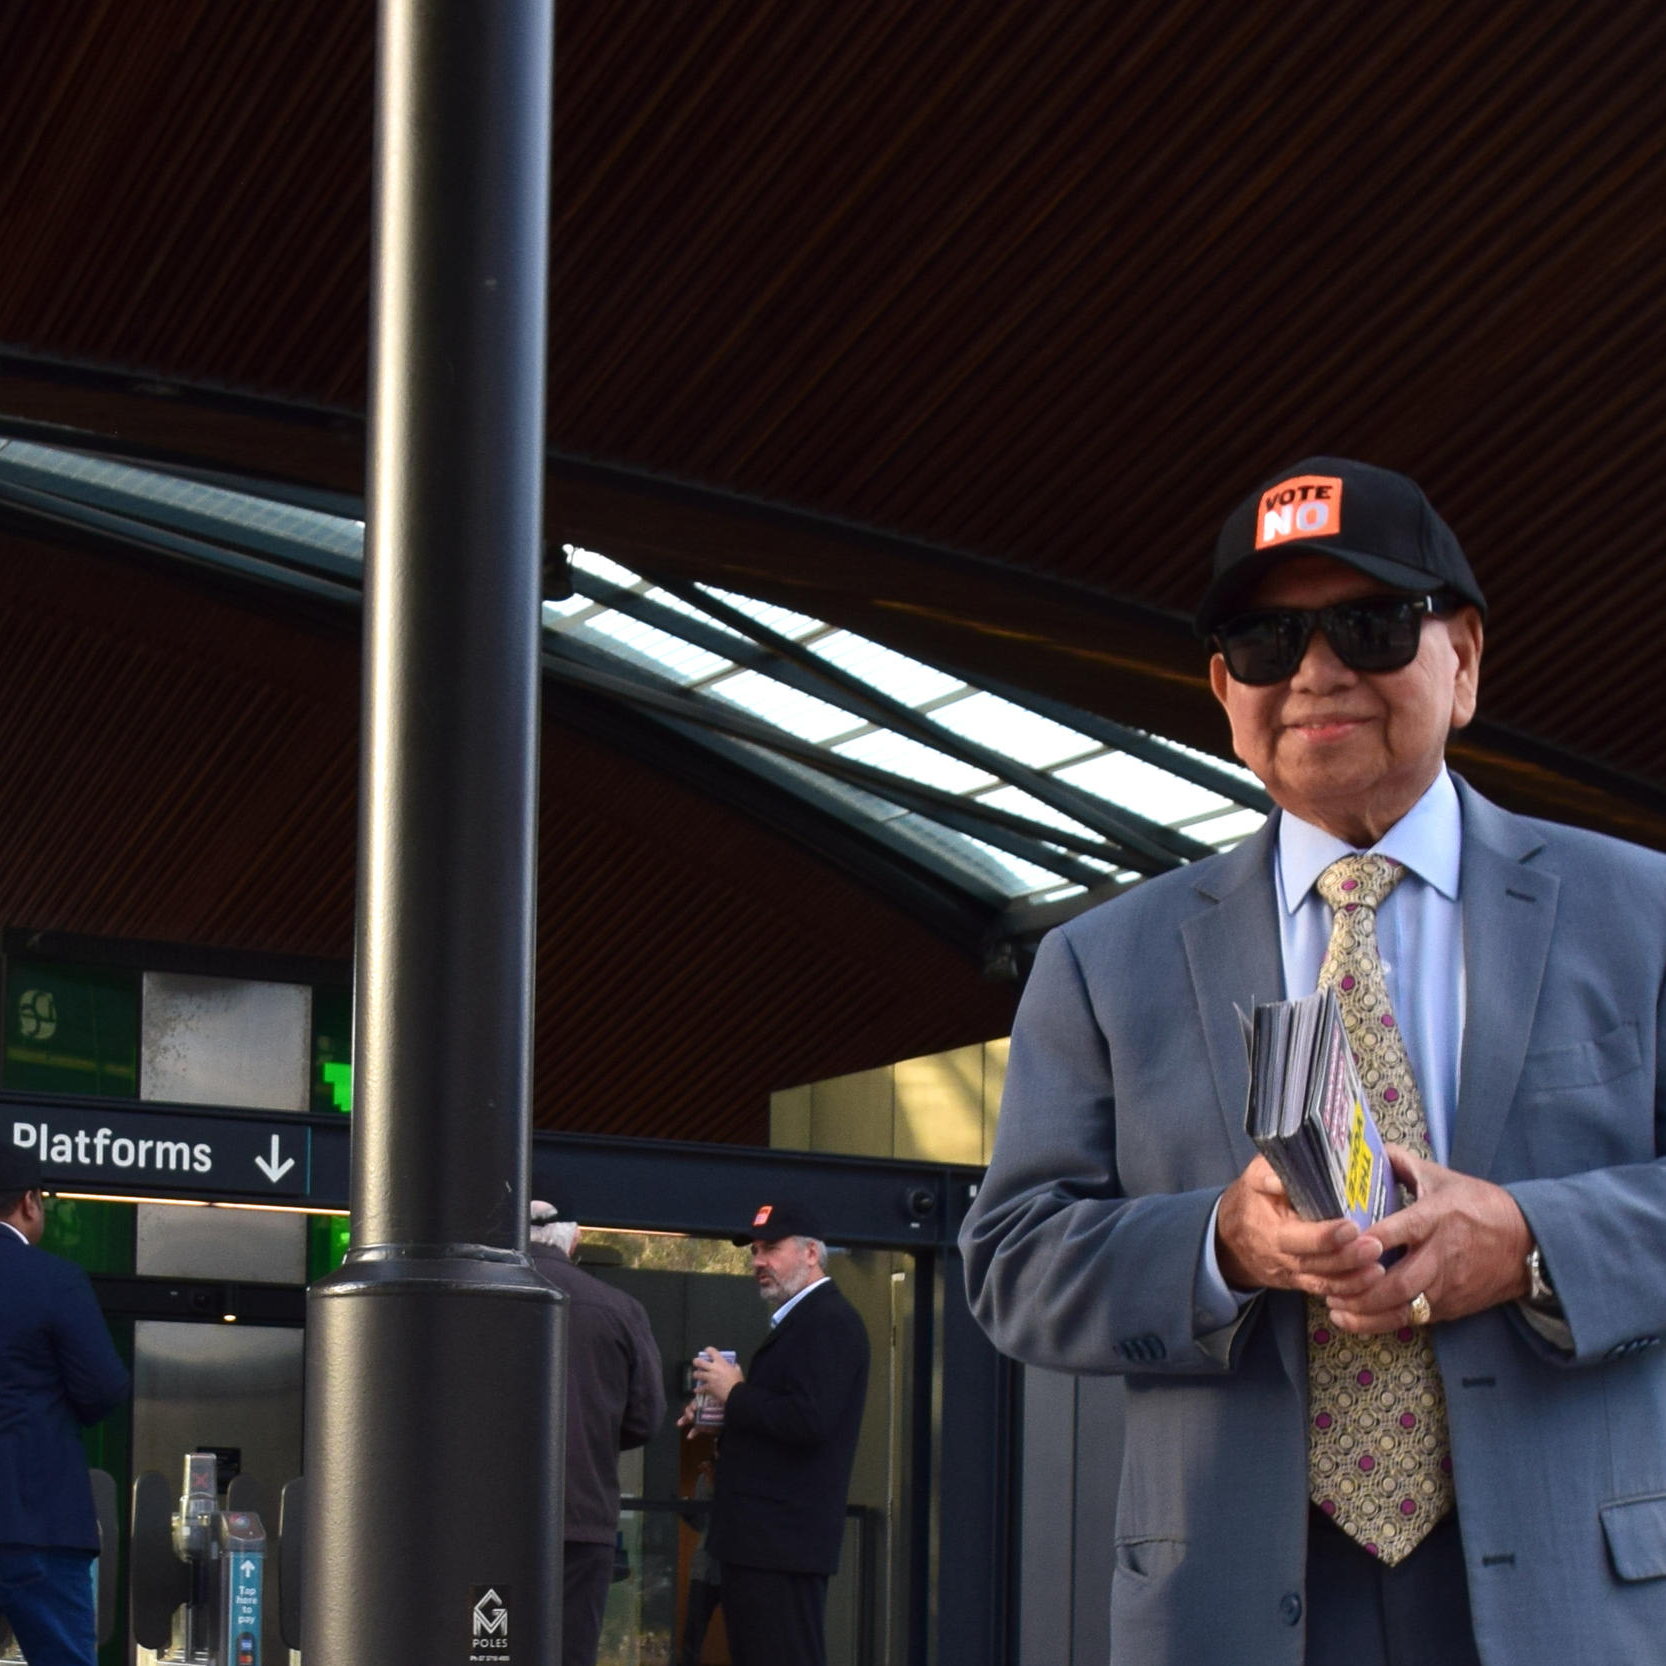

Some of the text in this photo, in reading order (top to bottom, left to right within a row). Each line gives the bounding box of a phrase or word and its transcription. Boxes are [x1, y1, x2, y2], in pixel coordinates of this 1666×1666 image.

[1265, 485, 1333, 511] VOTE
[1263, 500, 1329, 542] NO
[13, 1121, 212, 1173] Platforms
[238, 1585, 256, 1596] Tap
[236, 1596, 257, 1605] here
[242, 1606, 252, 1614] to
[238, 1616, 256, 1625] pay
[472, 1638, 508, 1649] POLES
